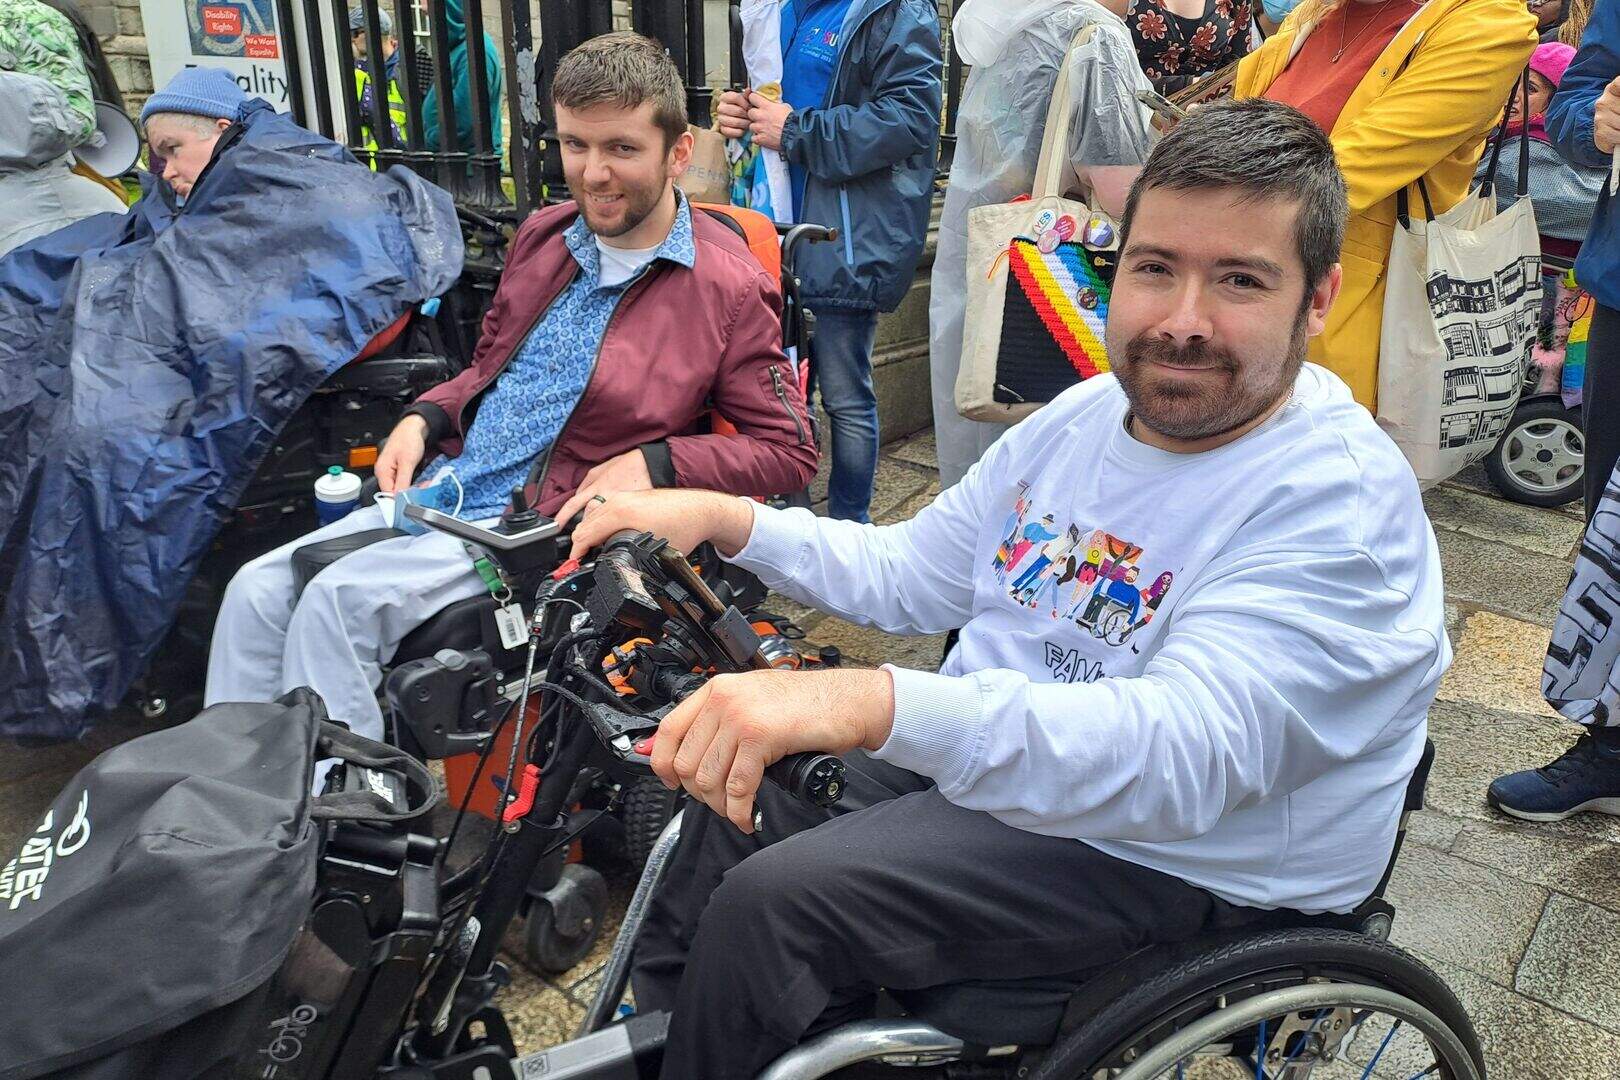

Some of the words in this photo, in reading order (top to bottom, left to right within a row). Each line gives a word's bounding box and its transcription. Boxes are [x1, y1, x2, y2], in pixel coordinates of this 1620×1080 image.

[205, 10, 238, 20] Disability
[211, 22, 234, 33] Rights
[245, 37, 258, 45] We
[259, 37, 276, 46] Want
[249, 47, 275, 57] Equality
[1034, 211, 1052, 230] YES
